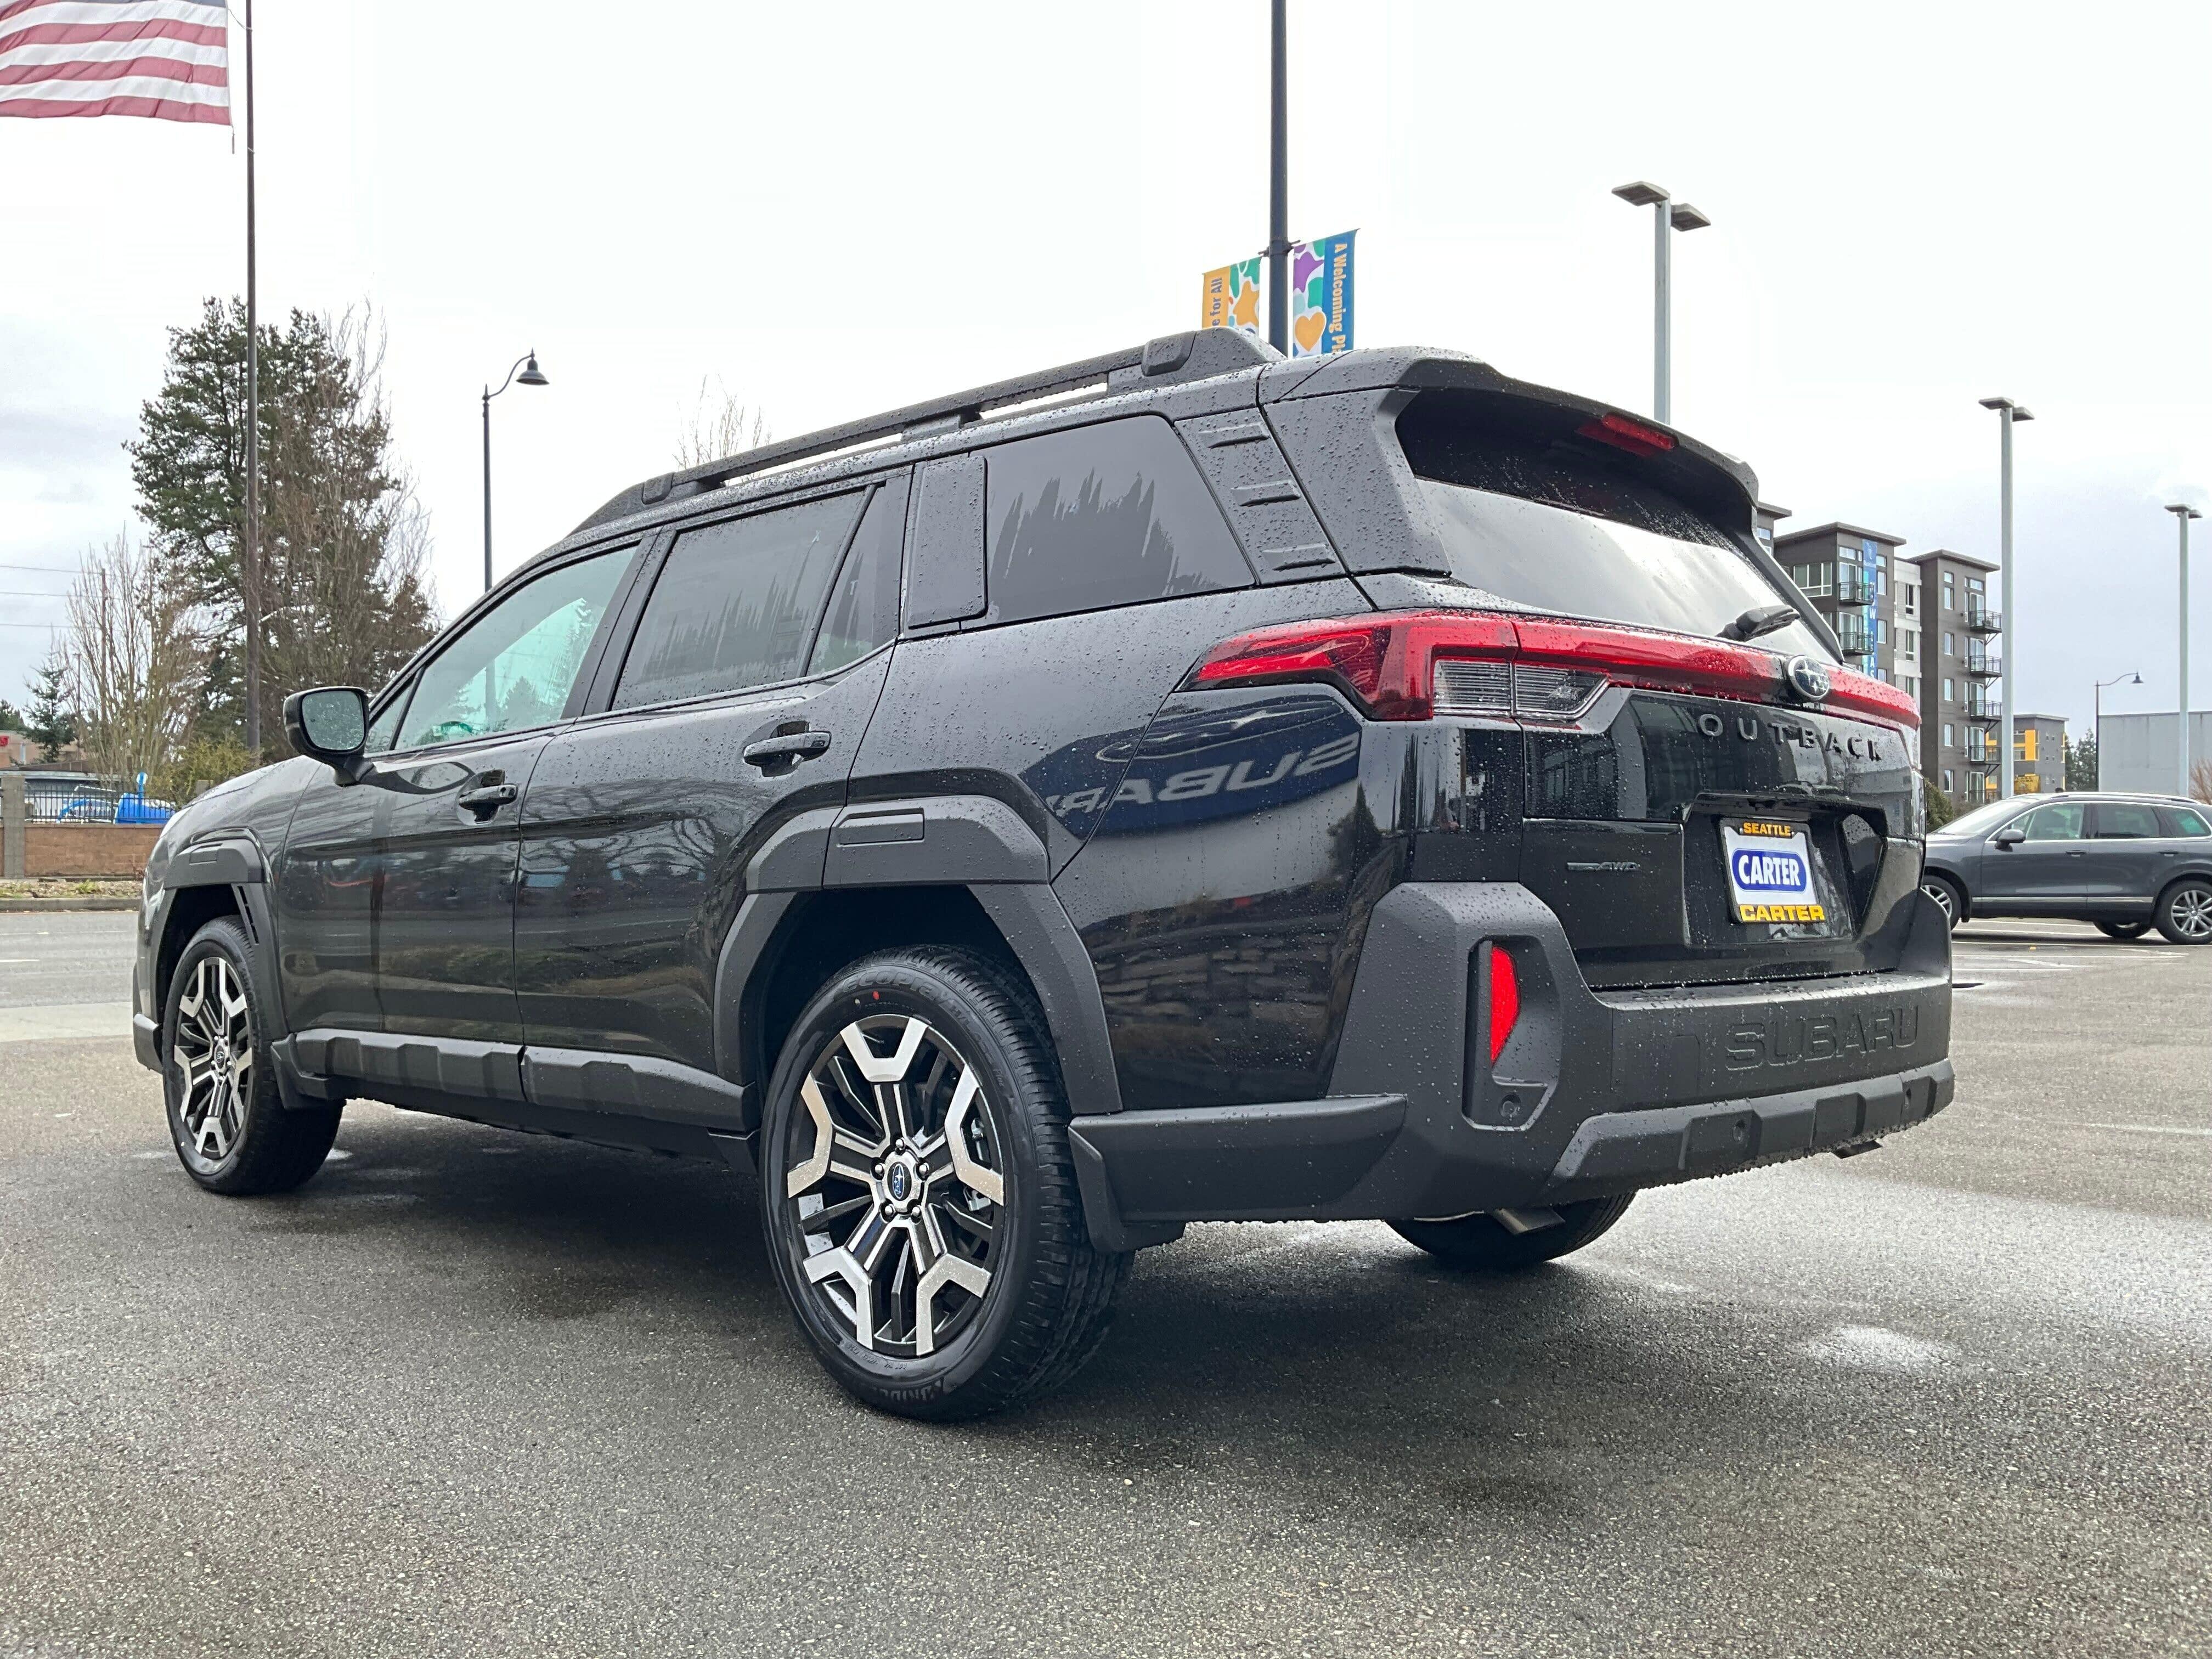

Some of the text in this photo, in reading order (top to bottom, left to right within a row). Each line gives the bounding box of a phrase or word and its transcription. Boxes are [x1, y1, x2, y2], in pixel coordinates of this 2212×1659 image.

[1335, 244, 1347, 253] A
[1211, 277, 1222, 293] All
[1329, 254, 1347, 334] Welcoming
[1210, 297, 1221, 316] for
[1698, 714, 1882, 761] OUTBACK
[1743, 822, 1791, 837] SEATTLE
[1738, 854, 1801, 886] CARTER
[1739, 904, 1825, 922] CARTER
[1725, 1005, 1918, 1071] SUBARU
